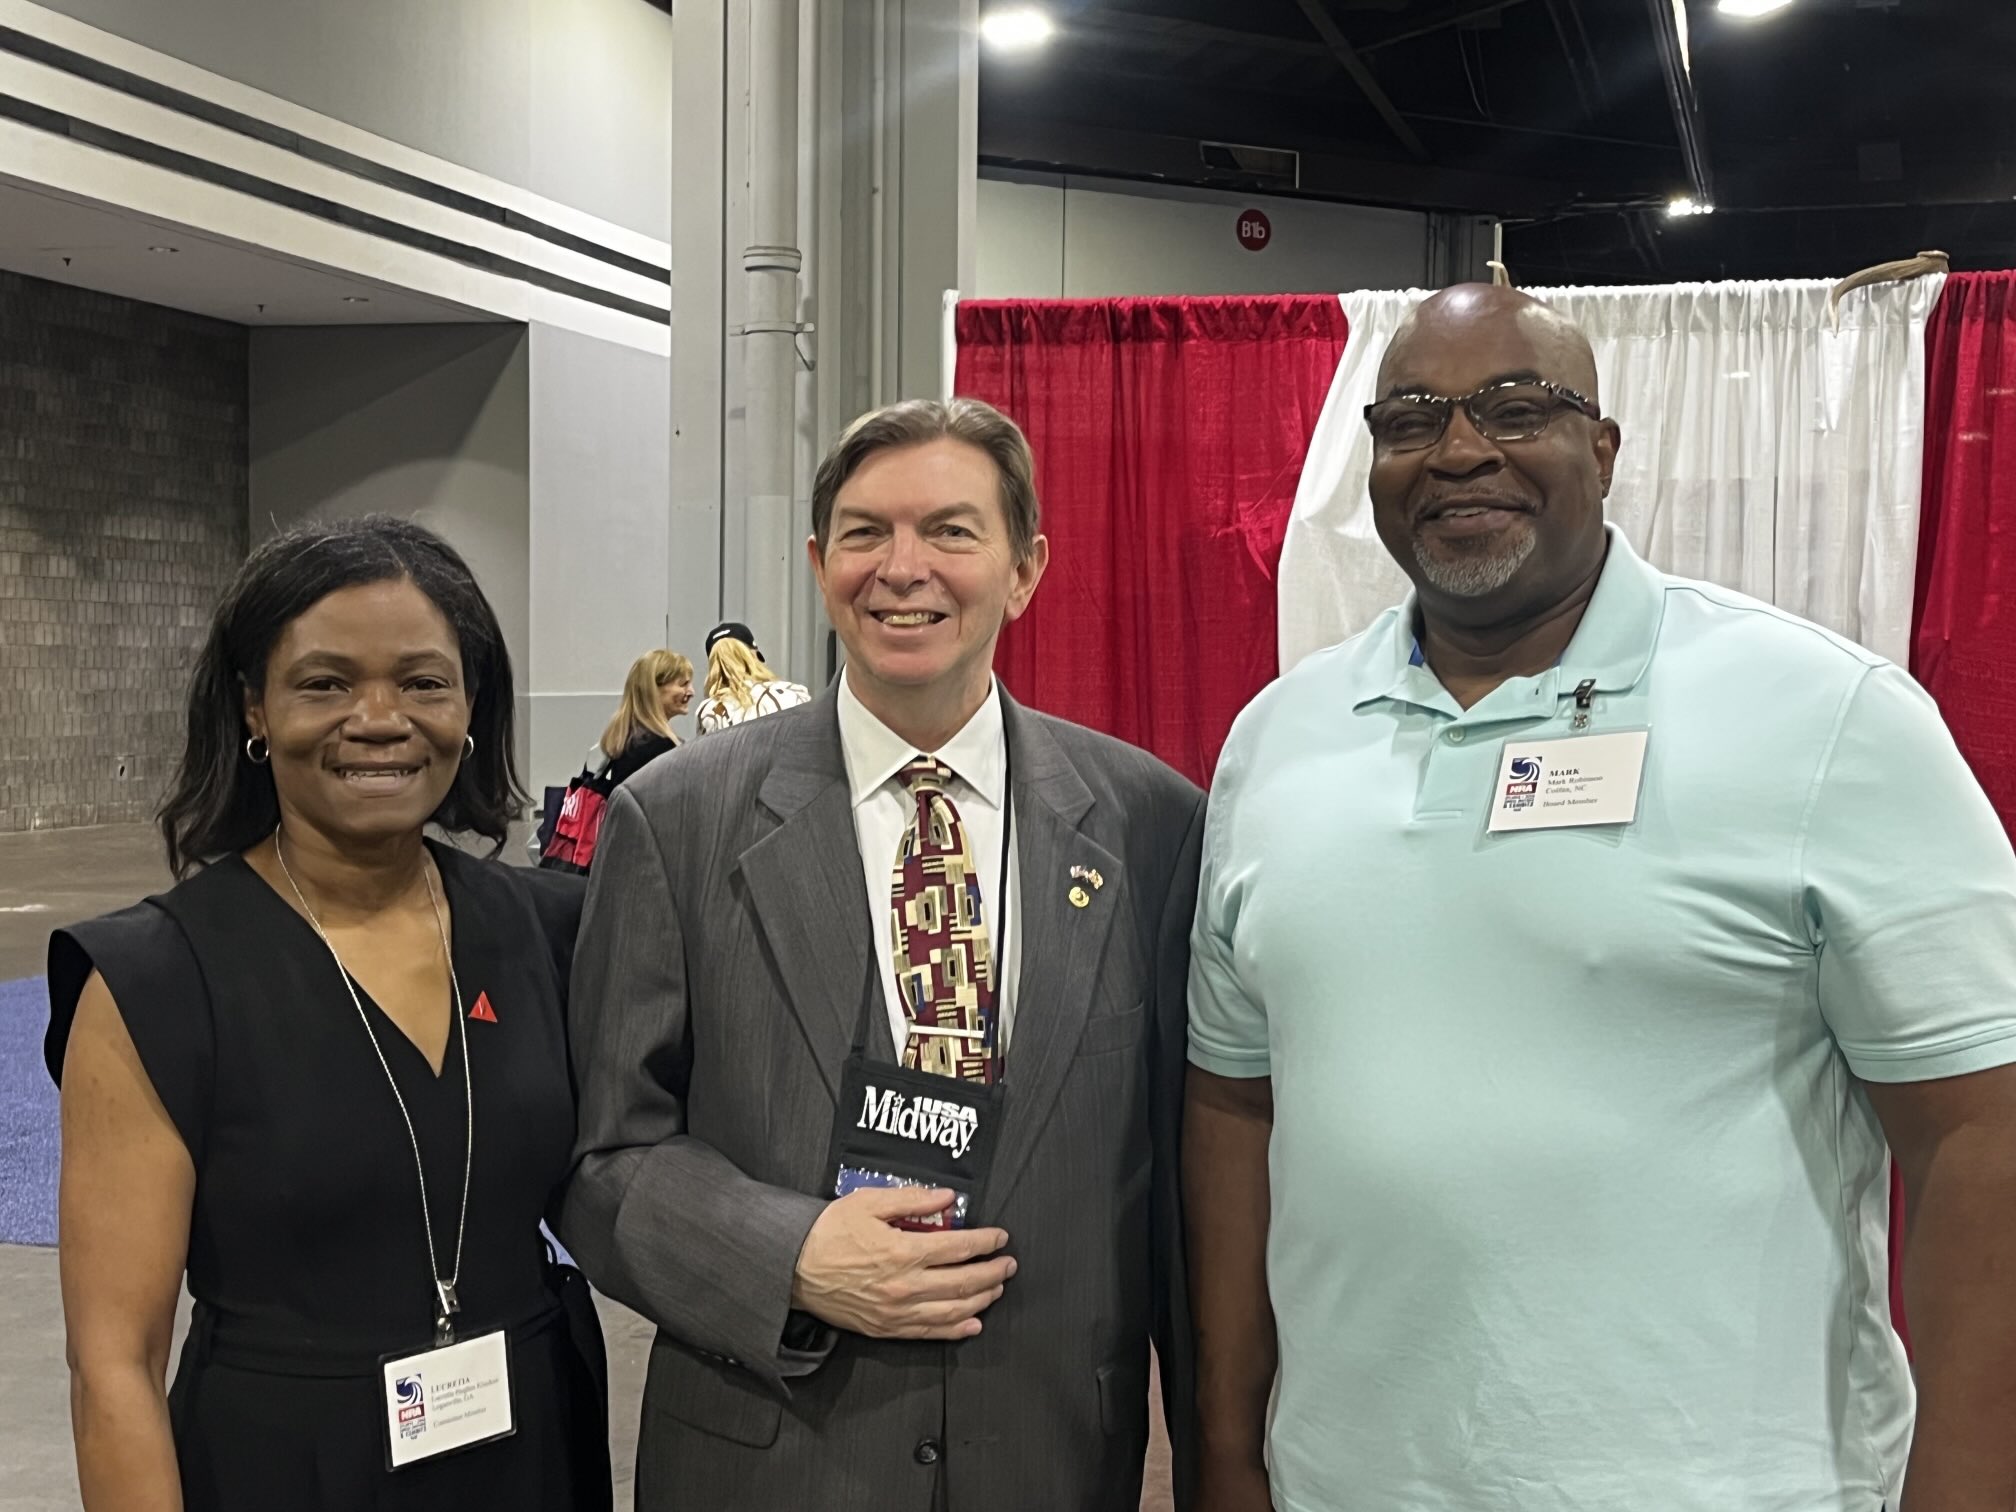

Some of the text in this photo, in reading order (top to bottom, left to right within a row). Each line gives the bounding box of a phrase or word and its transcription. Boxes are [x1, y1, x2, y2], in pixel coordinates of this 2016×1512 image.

[1242, 220, 1266, 239] B1b
[1549, 768, 1580, 777] MARK
[857, 1085, 978, 1158] Midway
[922, 1097, 977, 1124] USA
